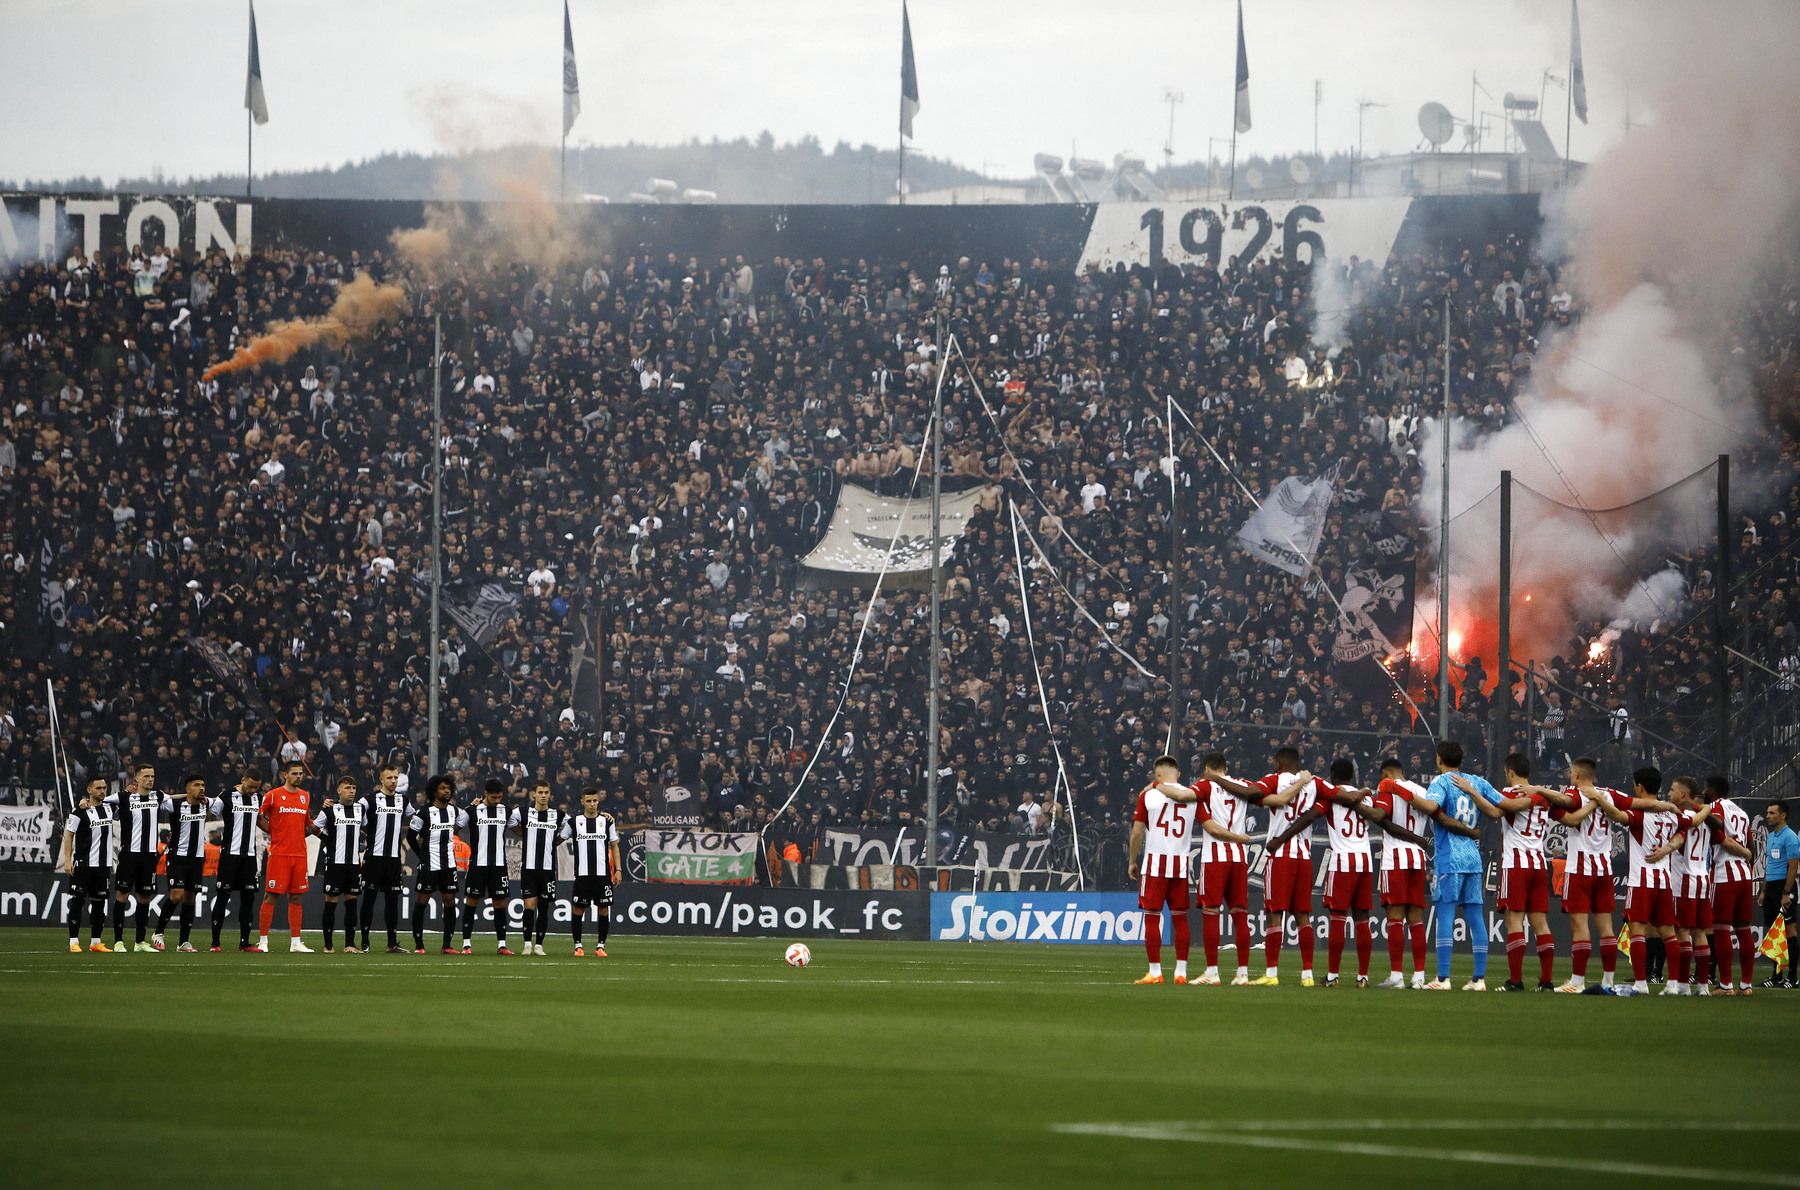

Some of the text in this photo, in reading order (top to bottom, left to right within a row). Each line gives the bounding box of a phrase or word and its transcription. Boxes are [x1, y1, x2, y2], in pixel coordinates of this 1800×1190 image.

[1140, 204, 1326, 265] 1926
[653, 816, 700, 825] HOOLIGANS
[1156, 802, 1187, 838] 45
[1224, 799, 1236, 832] 7
[659, 832, 744, 853] PAOK
[658, 856, 743, 878] GATE 4
